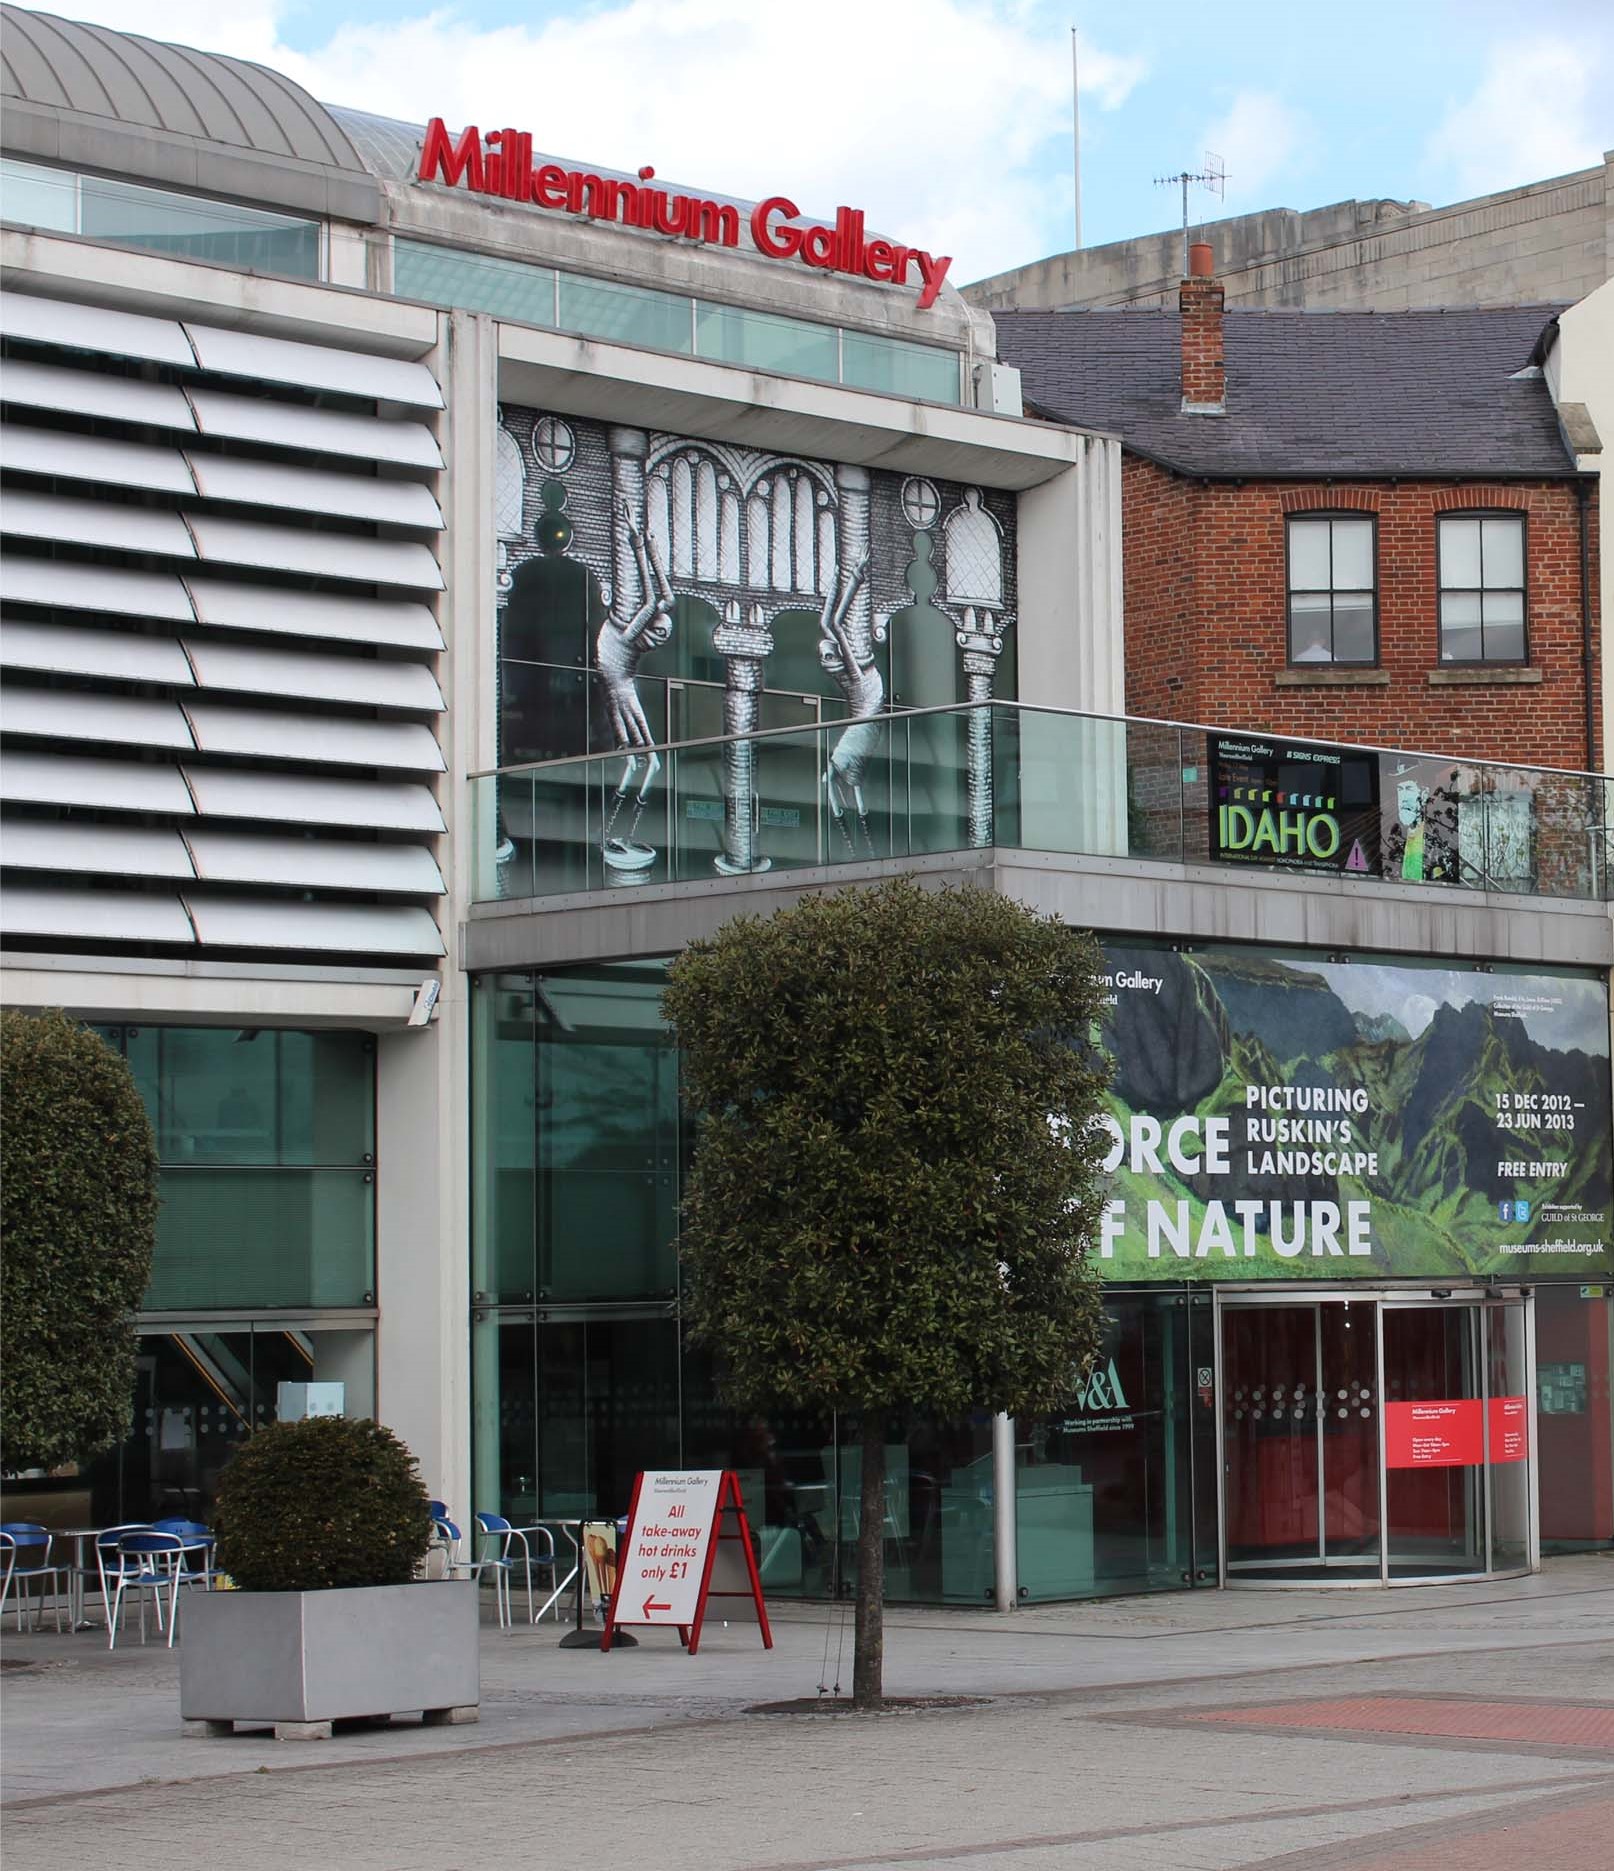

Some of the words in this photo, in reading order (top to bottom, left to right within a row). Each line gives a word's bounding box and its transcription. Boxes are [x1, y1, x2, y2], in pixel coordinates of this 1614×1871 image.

[418, 116, 739, 247] Millennium
[750, 196, 952, 309] Gallery
[1218, 740, 1250, 752] Millennium
[1251, 743, 1274, 757] Gallery
[1218, 804, 1341, 859] IDAHO
[1115, 970, 1164, 995] Gallery
[1246, 1085, 1369, 1113] PICTURING
[1496, 1093, 1510, 1109] 15
[1514, 1093, 1539, 1110] DEC
[1541, 1094, 1571, 1111] 2012
[1496, 1112, 1512, 1128] 23
[1514, 1113, 1541, 1129] JUN
[1544, 1113, 1575, 1130] 2013
[1087, 1115, 1231, 1175] ORCE
[1247, 1150, 1378, 1176] LANDSCAPE
[1497, 1161, 1526, 1177] FREE
[1529, 1162, 1568, 1177] ENTRY
[1541, 1213, 1563, 1222] GUILD
[1578, 1213, 1605, 1222] GEORGE
[1146, 1200, 1372, 1259] NATURE
[1499, 1238, 1604, 1256] museums-sheffield.org.uk
[668, 1505, 684, 1518] All
[642, 1524, 702, 1540] take-away
[638, 1544, 658, 1558] hot
[660, 1544, 697, 1558] drinks
[641, 1566, 666, 1582] only
[669, 1562, 689, 1579] £1
